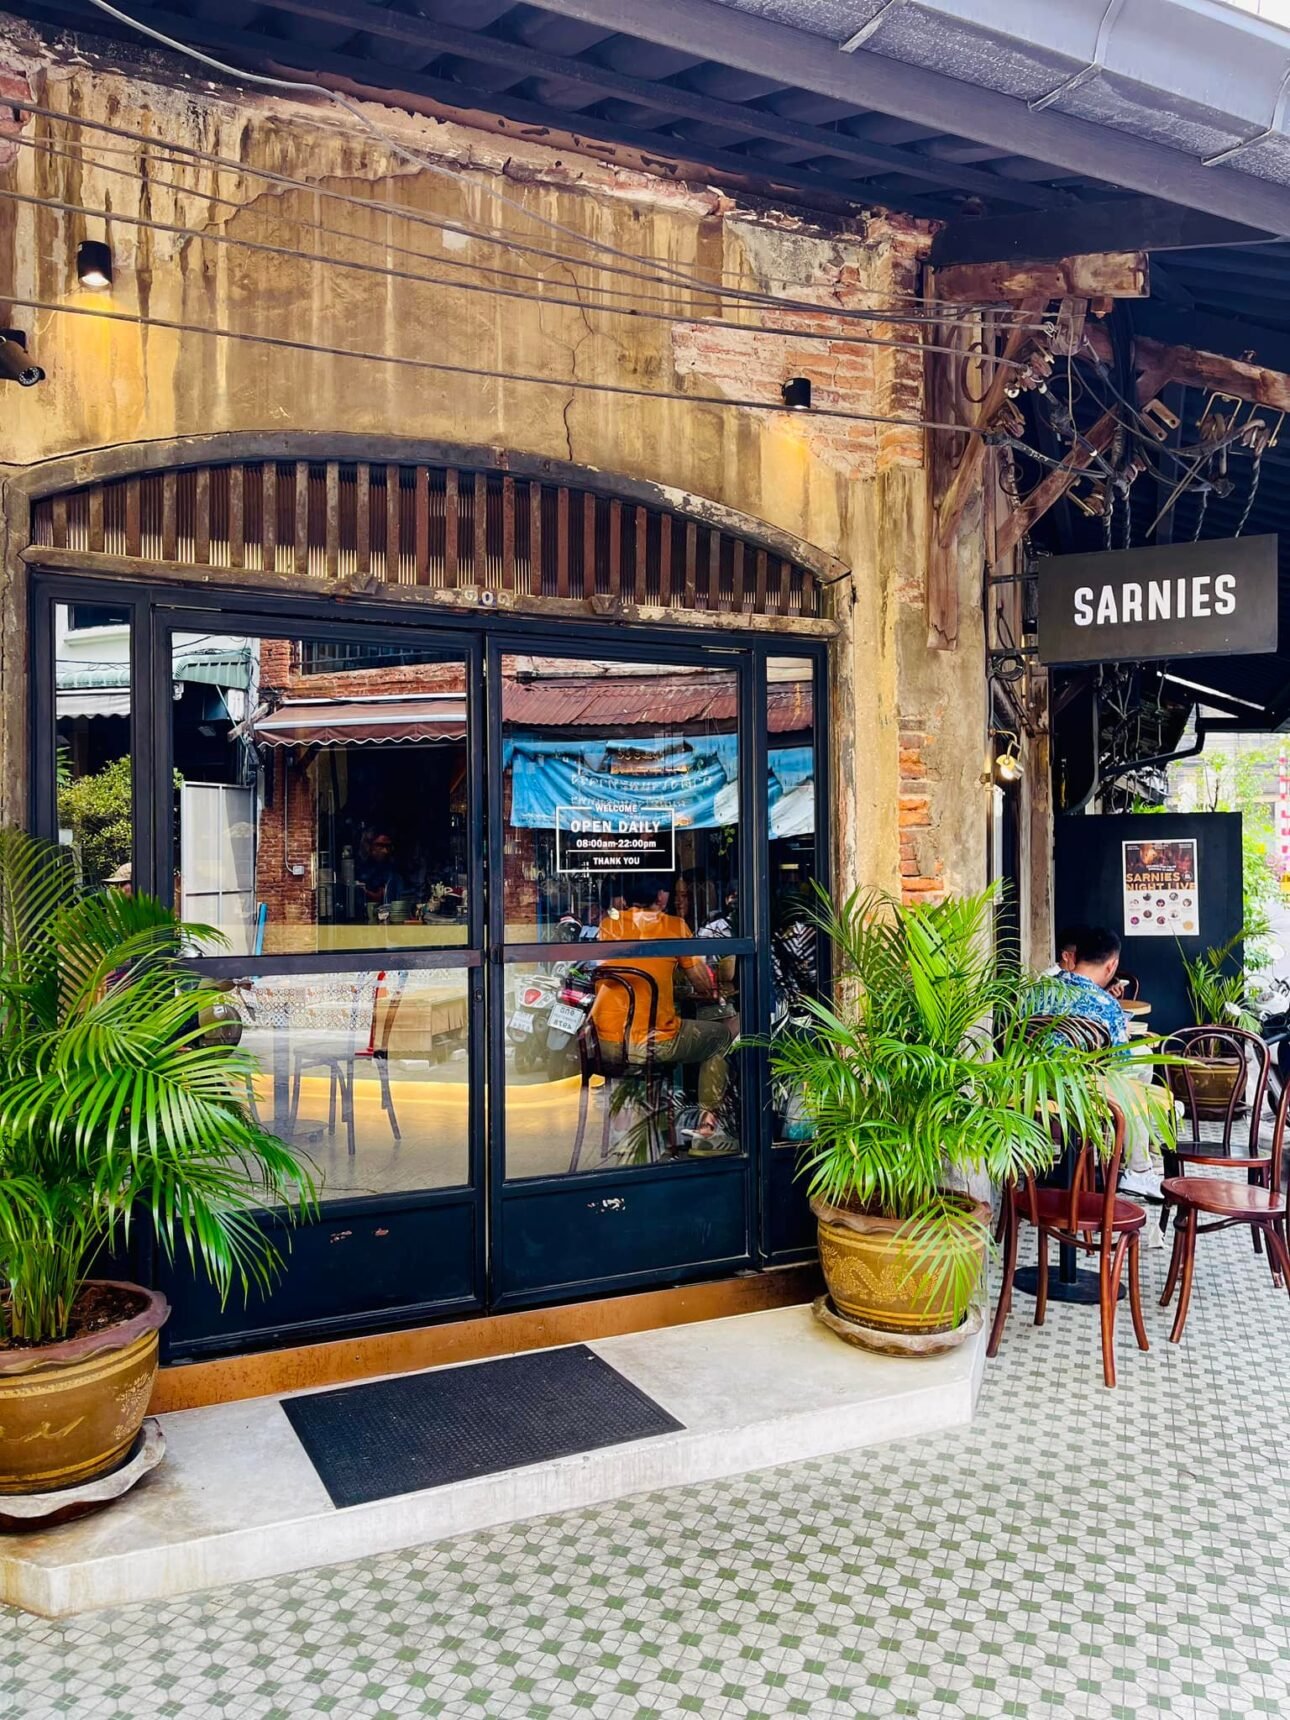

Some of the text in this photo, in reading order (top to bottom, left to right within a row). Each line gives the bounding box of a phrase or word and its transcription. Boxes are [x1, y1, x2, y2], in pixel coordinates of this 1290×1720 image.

[1074, 574, 1236, 626] SARNIES
[595, 804, 637, 813] WELCOME
[571, 820, 660, 833] OPEN DAILY
[576, 839, 657, 849] 08:00am-22:00pm
[593, 857, 640, 865] THANK YOU
[1126, 872, 1181, 882] SARNIES
[1126, 882, 1196, 891] NIGHT LIVE
